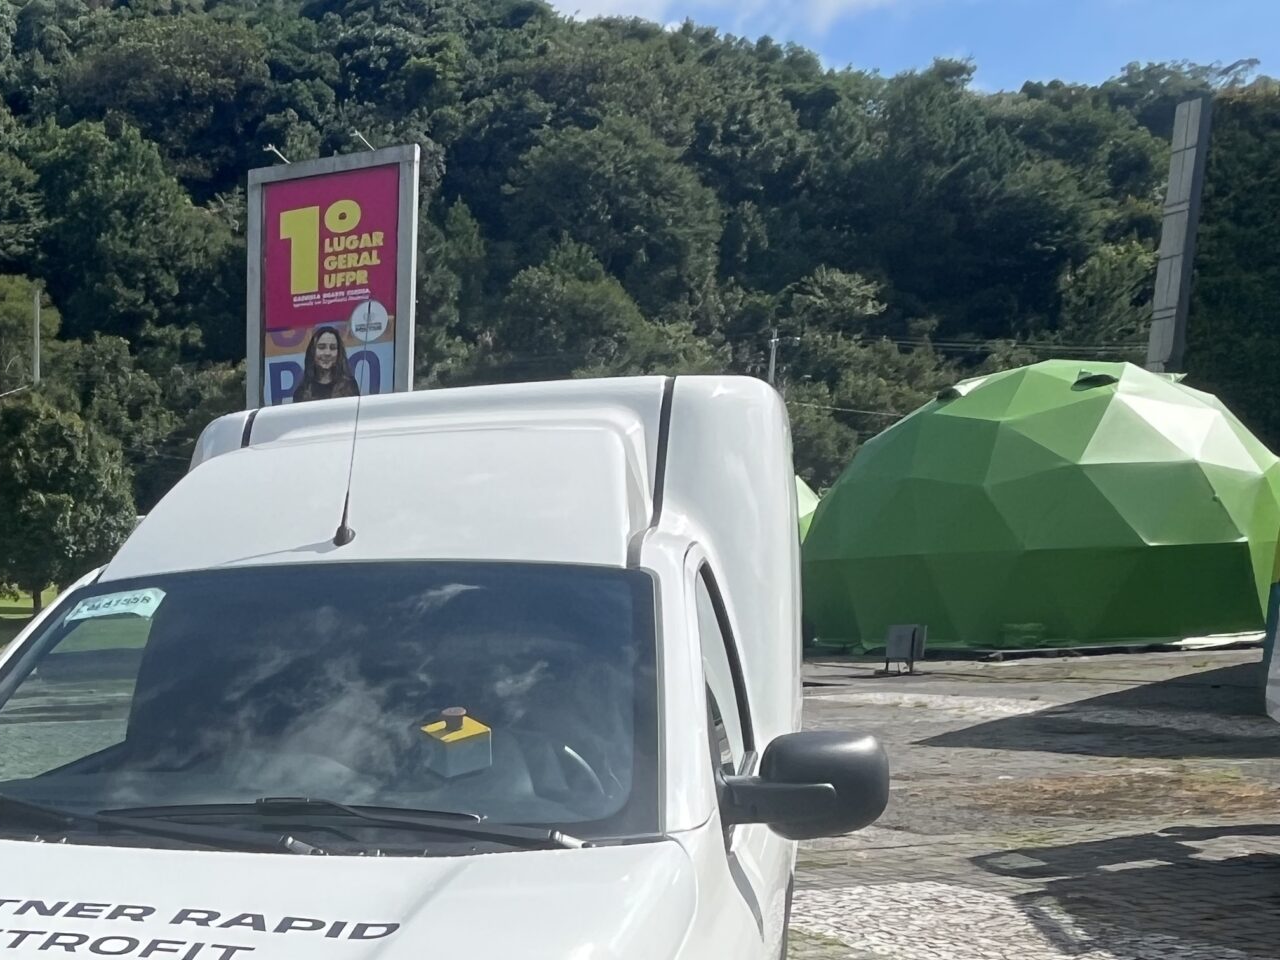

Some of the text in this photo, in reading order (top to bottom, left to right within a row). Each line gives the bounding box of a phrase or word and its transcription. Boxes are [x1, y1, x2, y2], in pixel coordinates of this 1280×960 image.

[324, 231, 384, 253] LUGAR
[324, 249, 380, 271] GERAL
[324, 269, 369, 290] UFPR
[169, 907, 402, 942] RAPID
